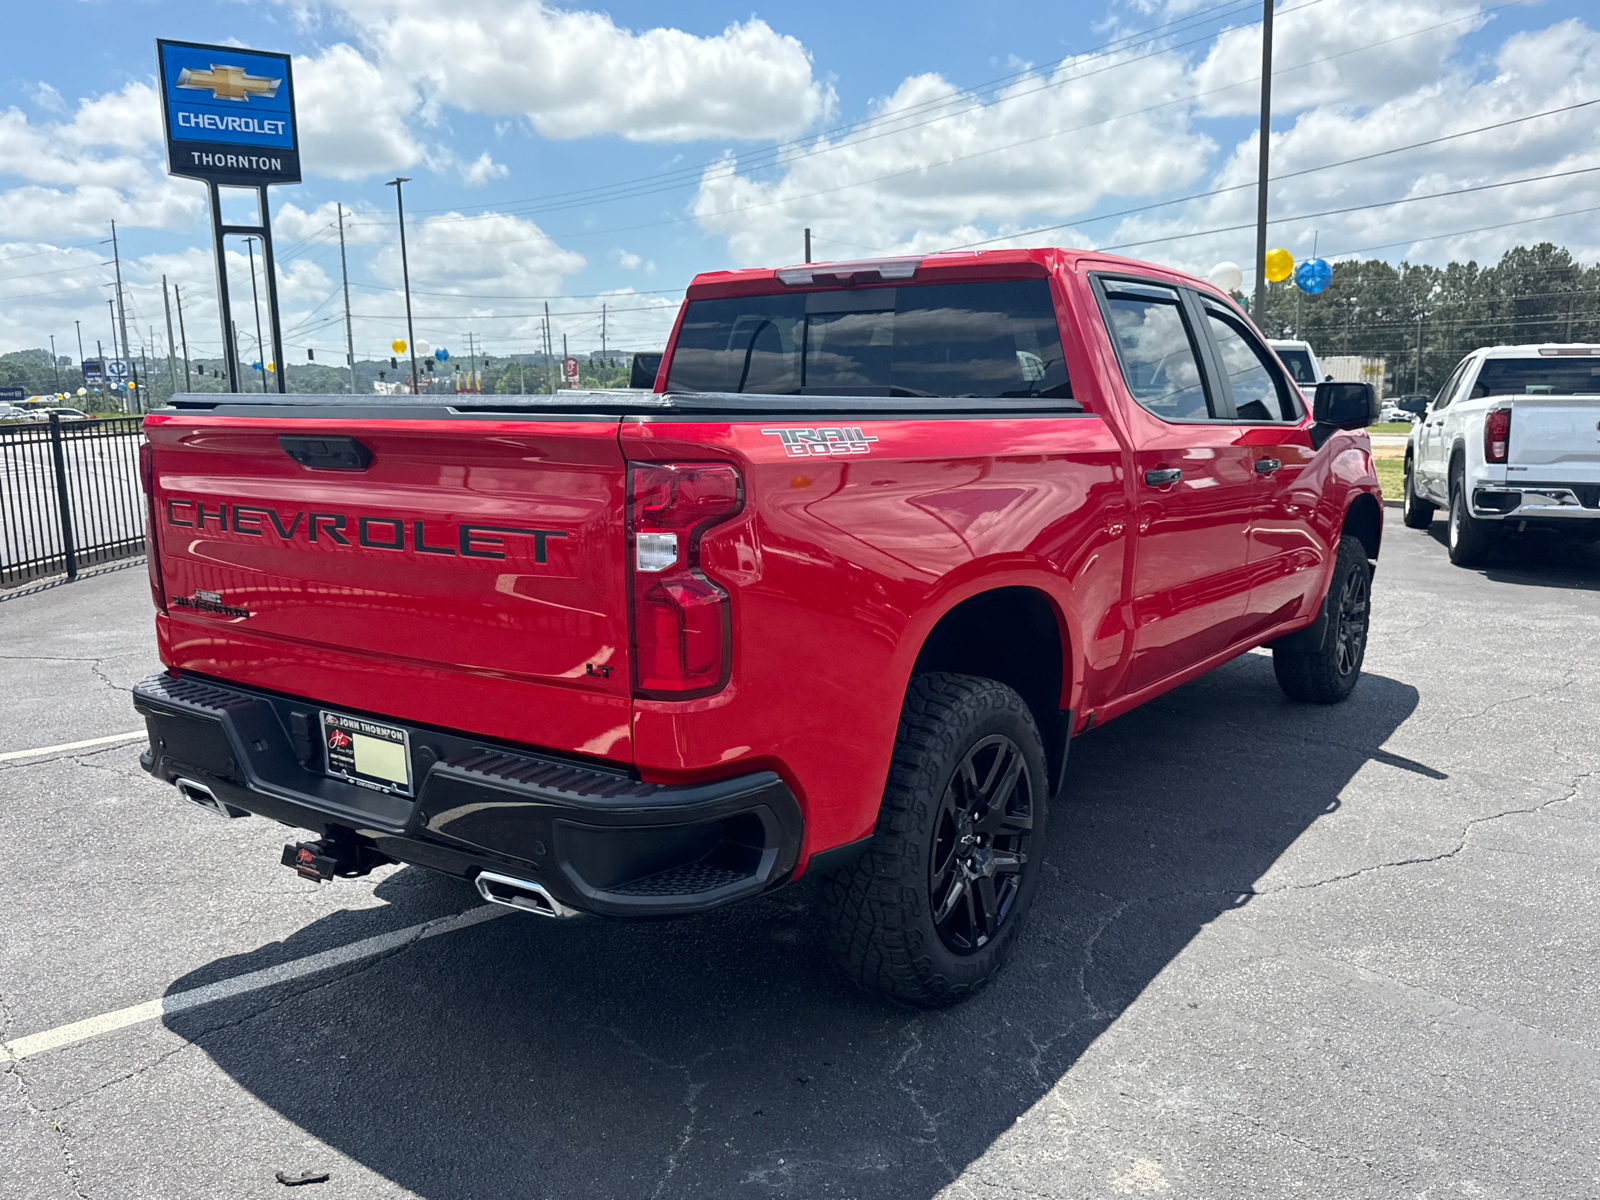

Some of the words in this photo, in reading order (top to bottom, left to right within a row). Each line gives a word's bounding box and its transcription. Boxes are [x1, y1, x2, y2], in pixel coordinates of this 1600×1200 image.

[178, 112, 285, 135] CHEVROLET
[191, 151, 282, 171] THORNTON
[761, 427, 879, 444] TRAIL
[783, 441, 871, 458] BOSS
[167, 499, 568, 564] CHEVROLET
[586, 663, 614, 678] LT
[339, 718, 360, 731] JOHN
